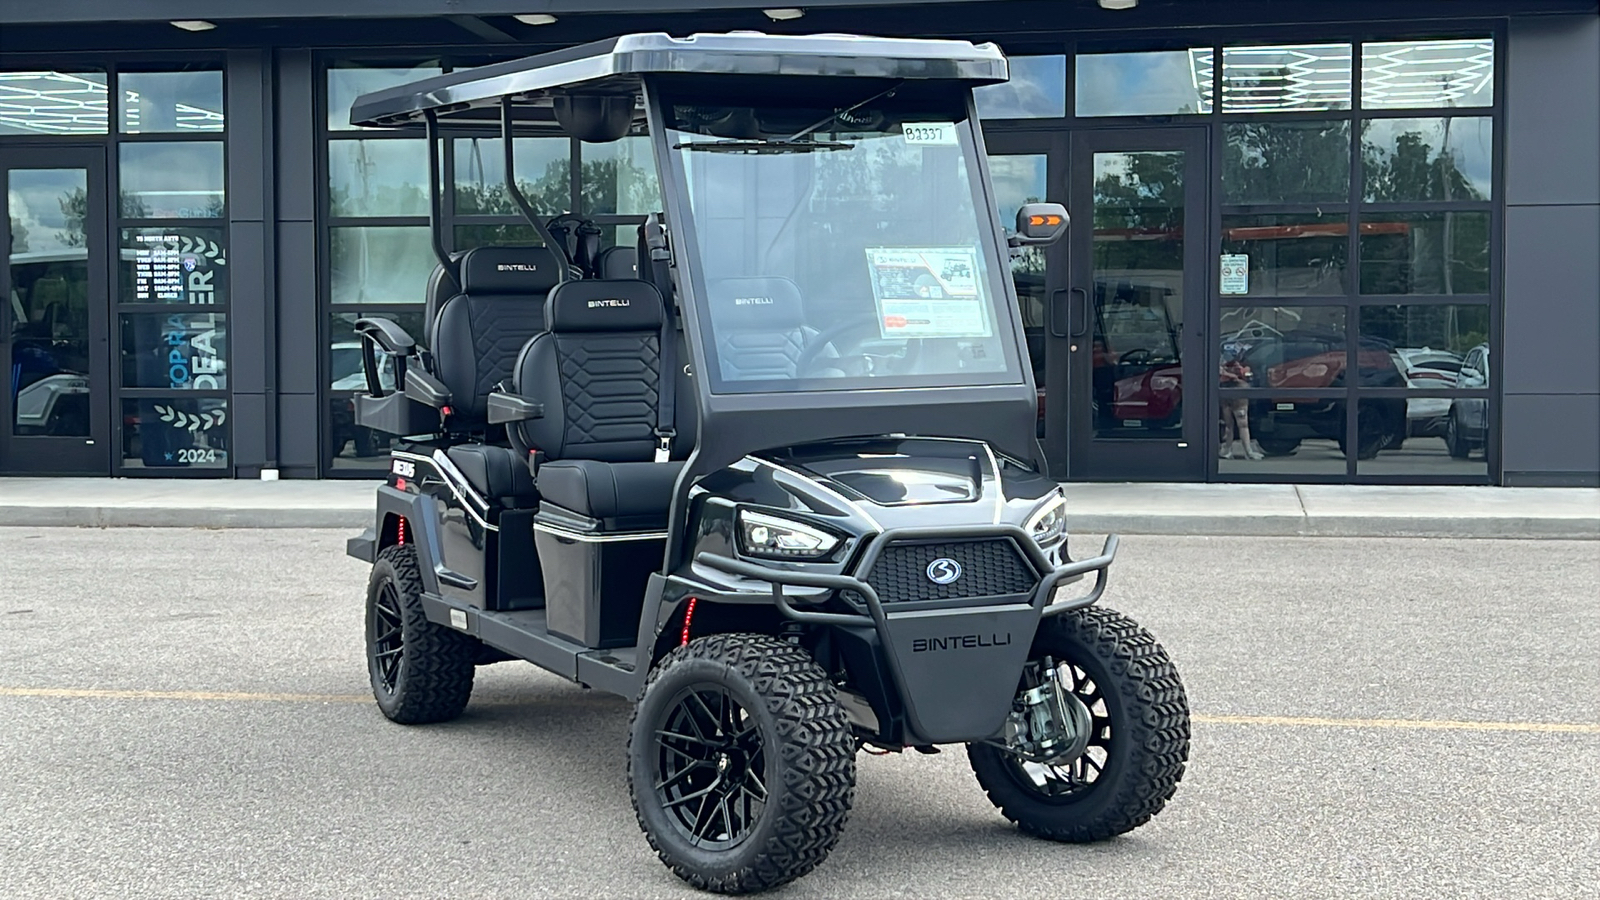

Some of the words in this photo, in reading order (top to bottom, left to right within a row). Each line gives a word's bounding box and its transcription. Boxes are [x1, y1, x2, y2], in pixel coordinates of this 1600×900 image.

[905, 127, 943, 141] B2337
[497, 264, 537, 272] BINTELLI
[587, 299, 630, 308] BINTELLI
[735, 297, 774, 305] BINTELLI
[177, 449, 216, 463] 2024
[912, 632, 1011, 652] BINTELLI
